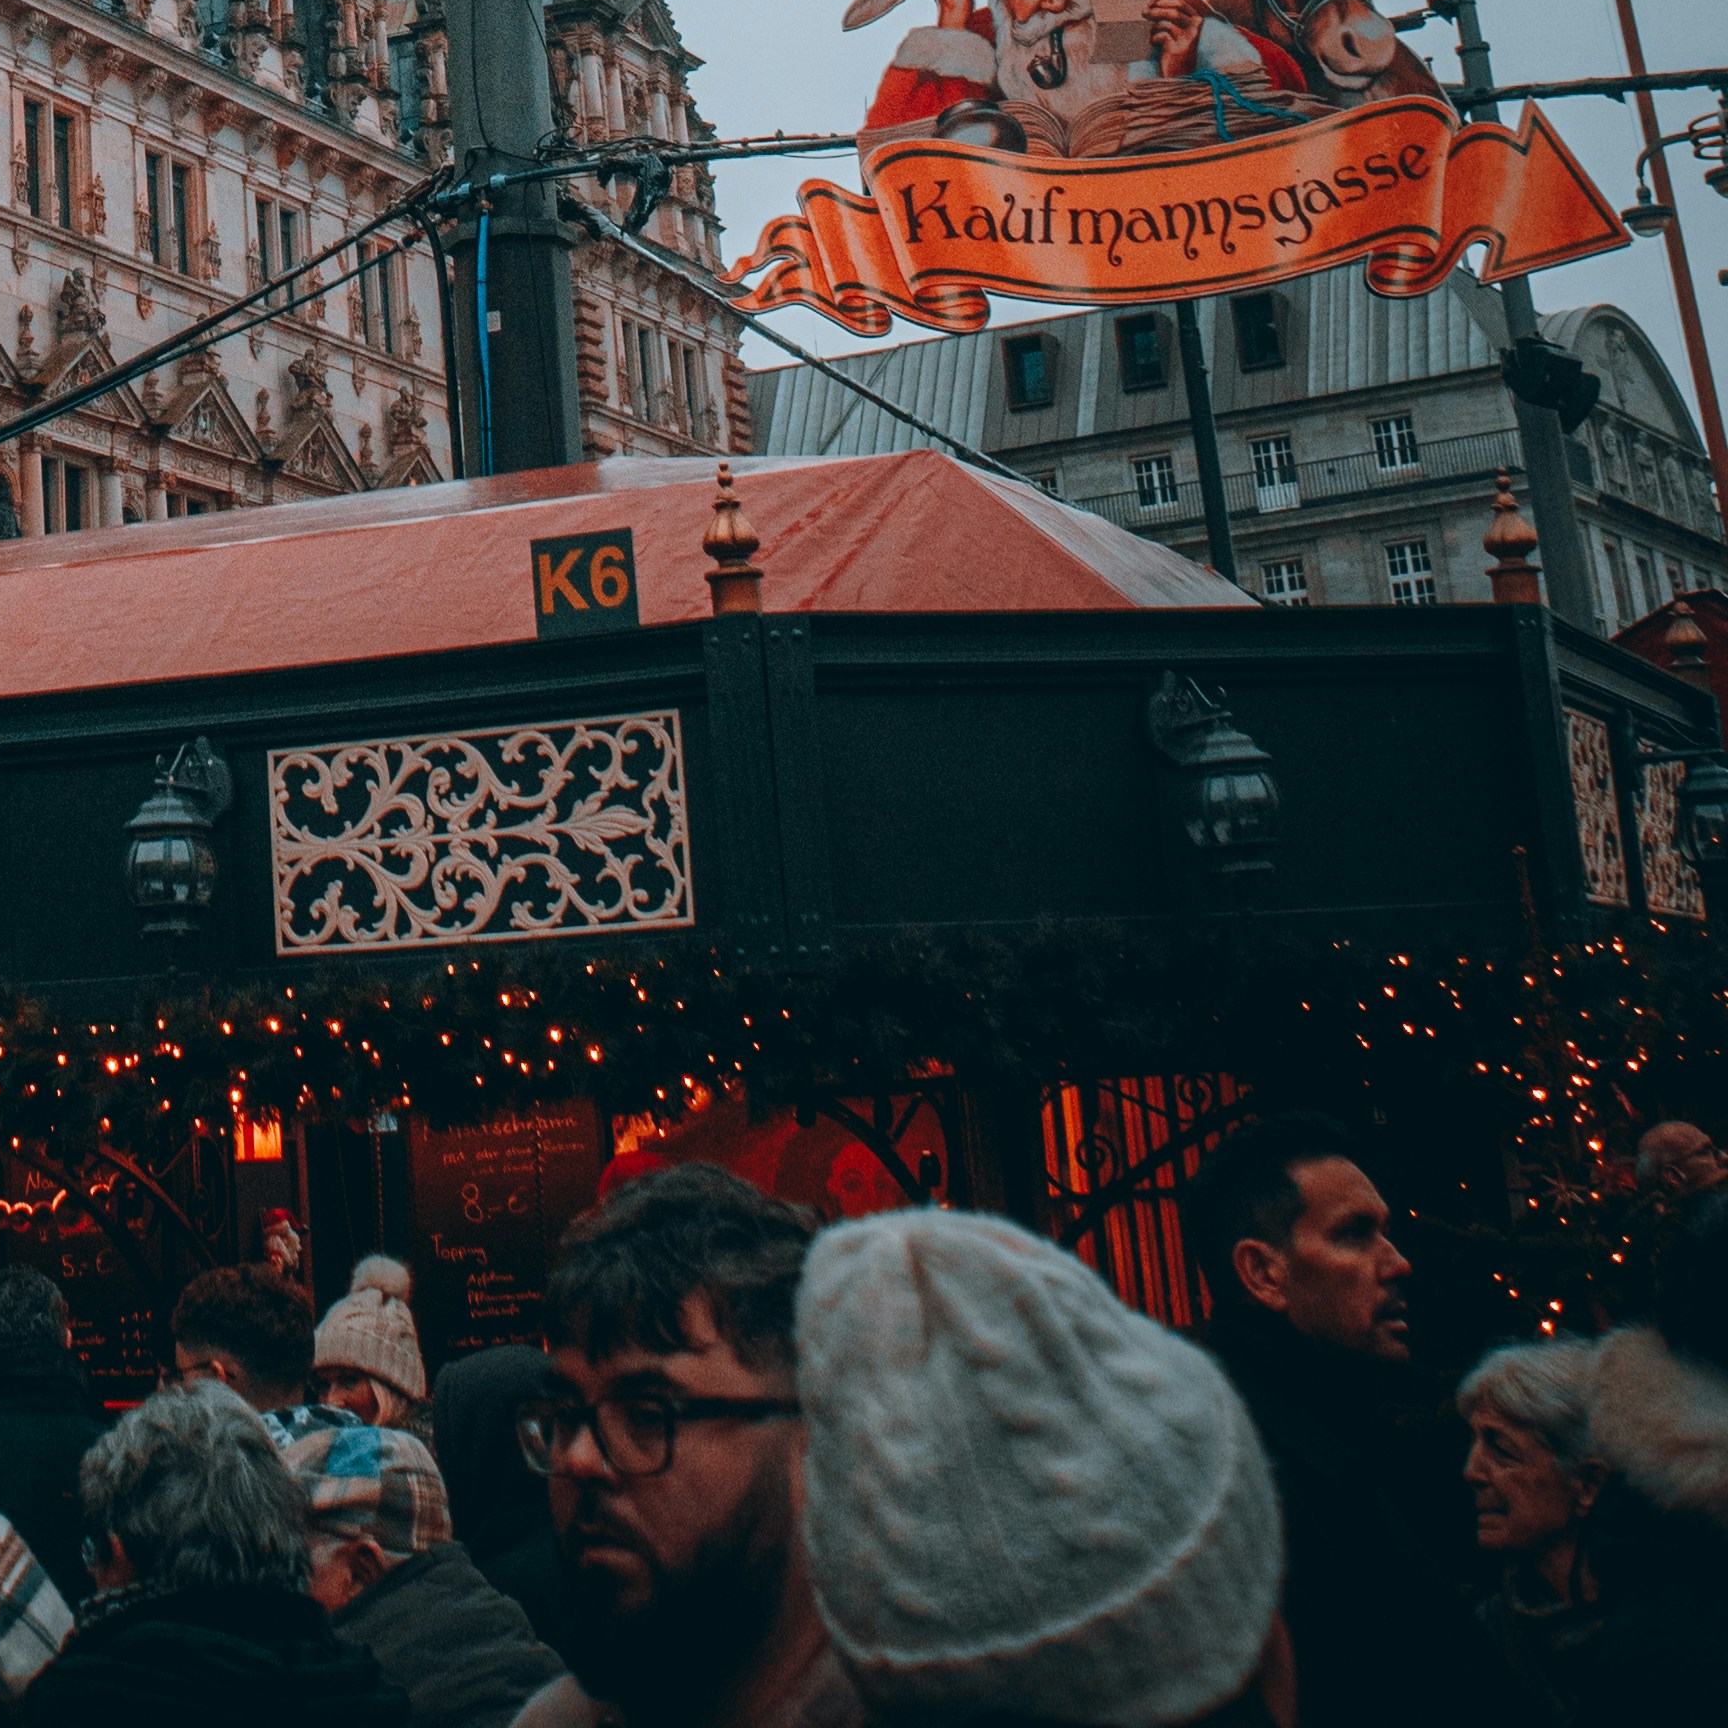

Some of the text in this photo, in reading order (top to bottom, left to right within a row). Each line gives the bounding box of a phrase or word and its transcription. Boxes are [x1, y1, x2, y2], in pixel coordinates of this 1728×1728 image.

[904, 144, 1431, 266] Kaufmannsgasse
[538, 546, 629, 615] K6
[430, 1232, 488, 1267] Topping
